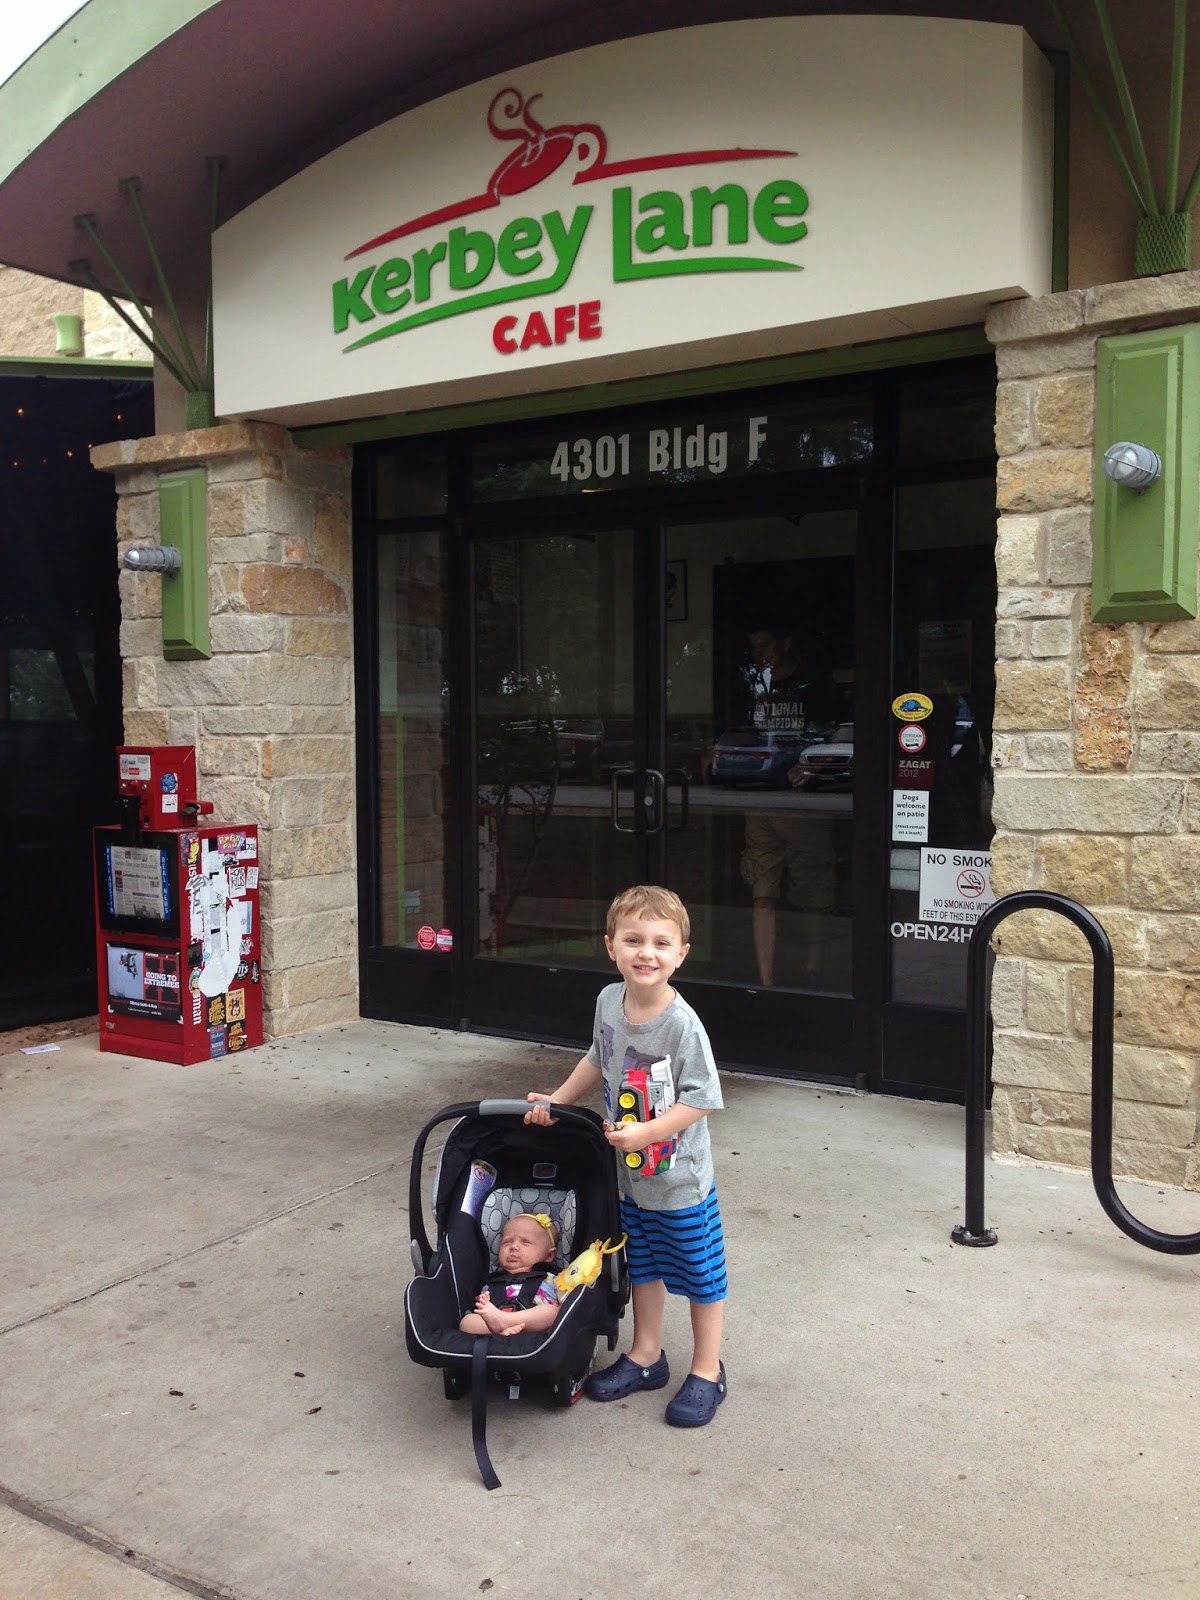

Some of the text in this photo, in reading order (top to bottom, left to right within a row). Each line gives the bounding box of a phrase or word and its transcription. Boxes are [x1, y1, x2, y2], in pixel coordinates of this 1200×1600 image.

[332, 178, 810, 342] Kerbey Lane
[492, 300, 603, 355] CAFE
[550, 416, 768, 482] 4301 Bldg F
[899, 760, 932, 769] ZAGAT
[898, 768, 919, 778] 2012
[902, 794, 919, 802] Dogs
[927, 853, 992, 868] NO SMOK
[933, 899, 942, 908] NO
[944, 899, 975, 910] SMOKING
[922, 909, 938, 919] FEET
[940, 911, 948, 920] OF
[950, 912, 964, 921] THIS
[146, 971, 178, 982] GOING TO
[144, 977, 180, 989] EXTREMES
